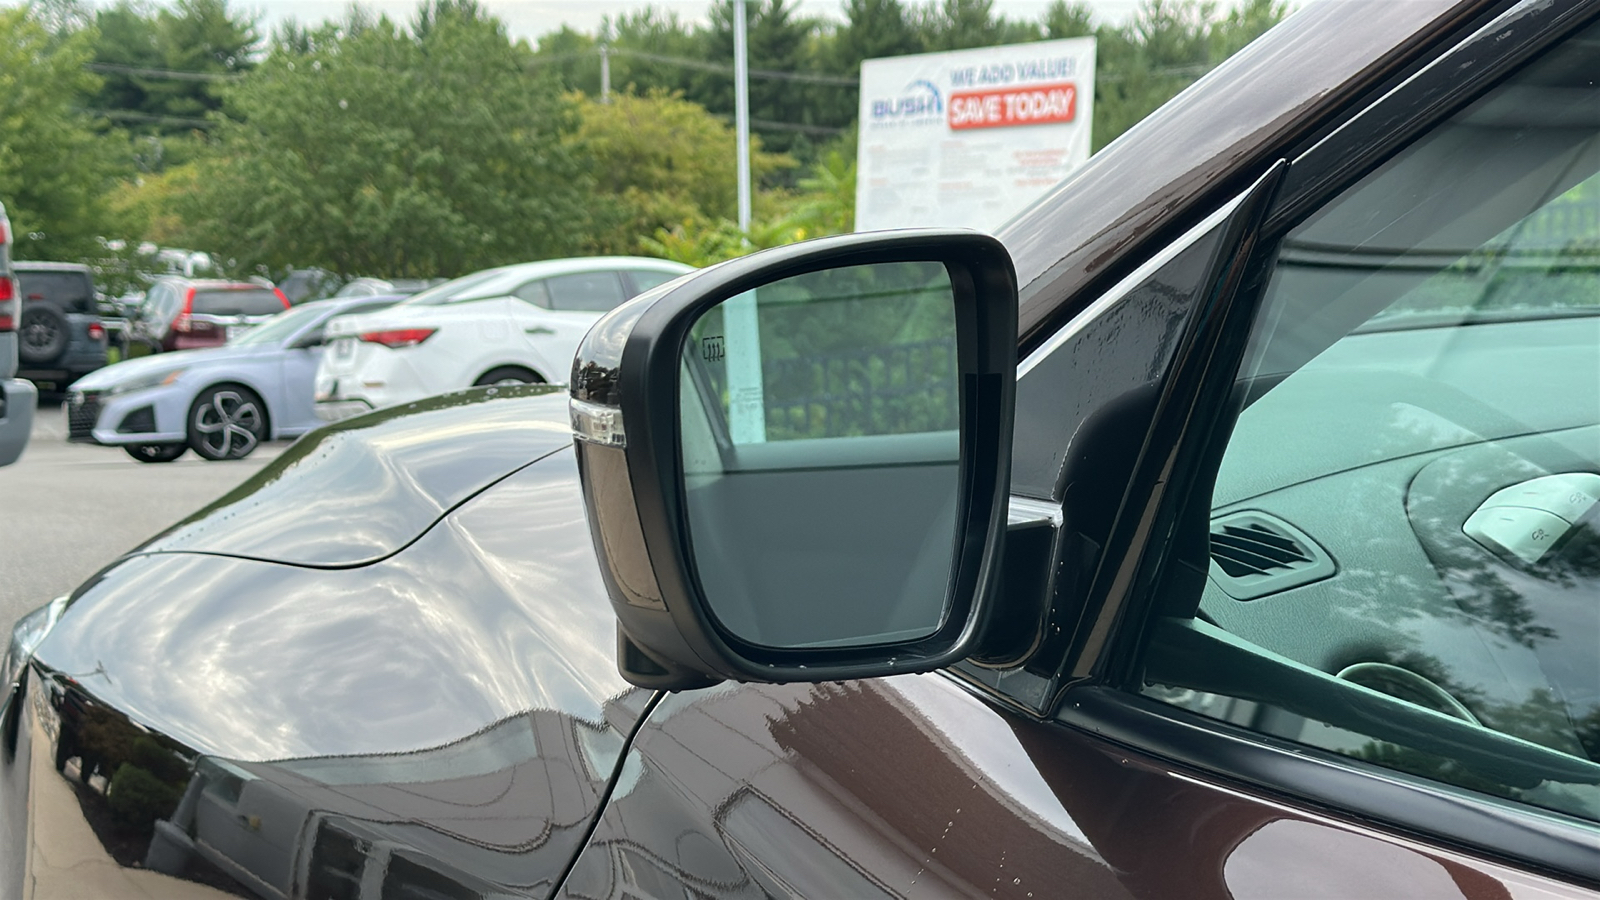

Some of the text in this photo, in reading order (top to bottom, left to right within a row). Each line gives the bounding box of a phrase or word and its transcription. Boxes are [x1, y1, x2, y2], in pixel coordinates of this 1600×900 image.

[950, 57, 1076, 87] WE ADD VALUE!
[951, 87, 1075, 124] SAVE TODAY
